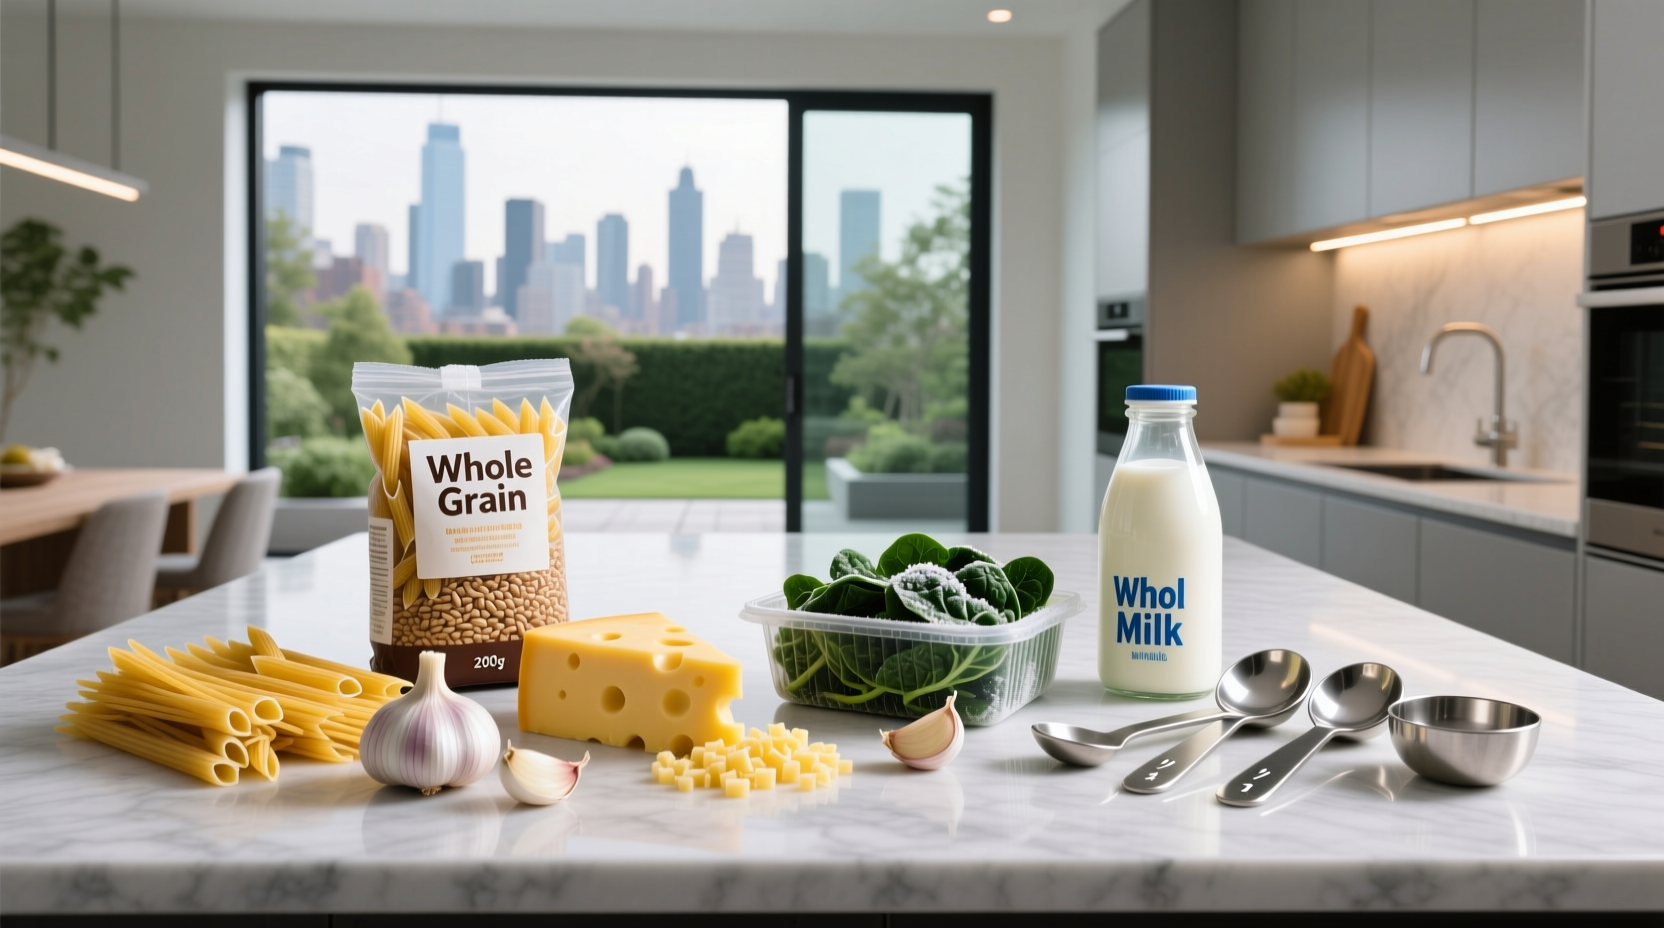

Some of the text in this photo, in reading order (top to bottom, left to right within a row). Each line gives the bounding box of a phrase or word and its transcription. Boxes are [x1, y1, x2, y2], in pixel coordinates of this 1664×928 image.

[426, 450, 532, 484] Whole
[438, 484, 527, 516] Grain
[1113, 575, 1185, 609] Whol
[1117, 611, 1183, 646] Milk
[473, 655, 506, 670] 200g
